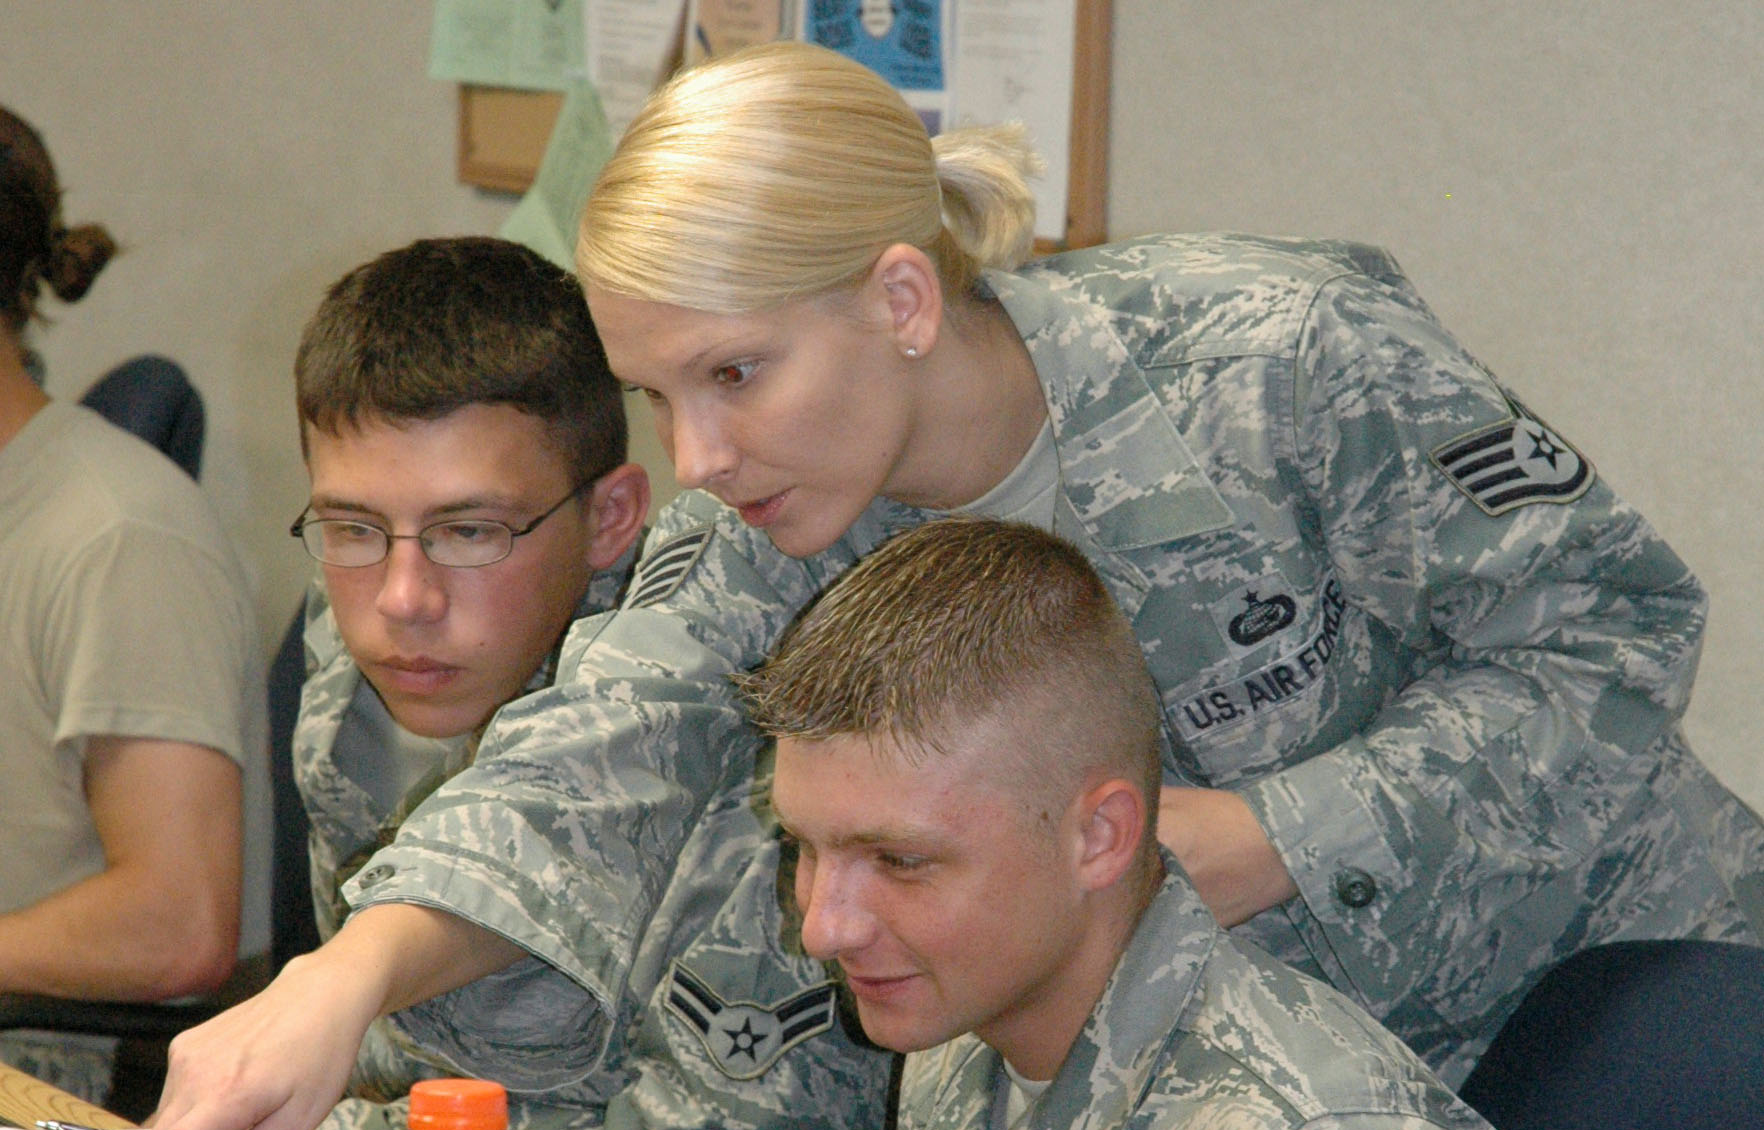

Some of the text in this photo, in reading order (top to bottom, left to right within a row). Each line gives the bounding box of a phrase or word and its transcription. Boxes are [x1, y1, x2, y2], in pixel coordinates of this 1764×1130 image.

[1183, 579, 1347, 729] U.S. AIR FORCE
